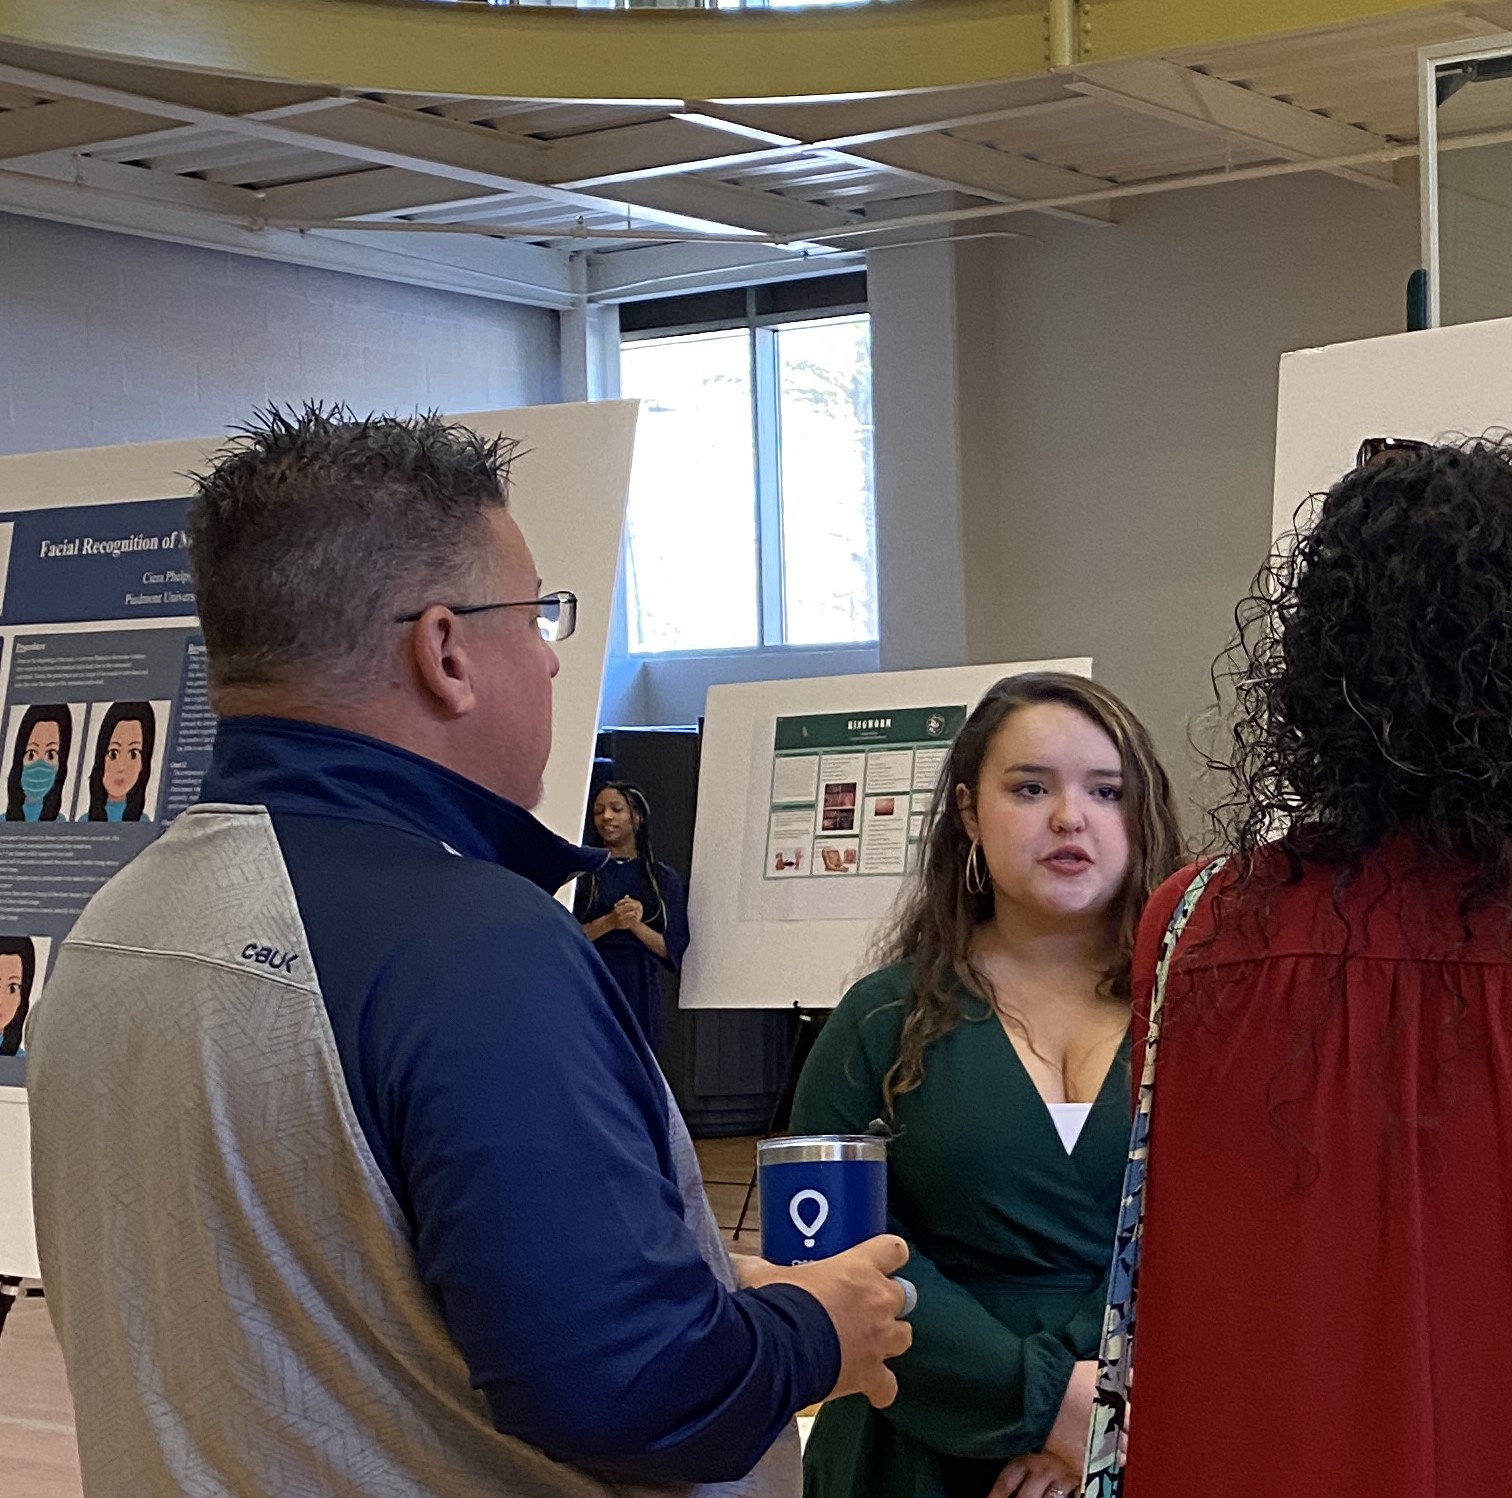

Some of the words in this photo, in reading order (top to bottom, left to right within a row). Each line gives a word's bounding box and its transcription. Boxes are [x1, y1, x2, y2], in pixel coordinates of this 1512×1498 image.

[40, 538, 79, 557] Facial
[82, 534, 158, 557] Recognition
[161, 531, 176, 549] of
[163, 590, 195, 603] Univers
